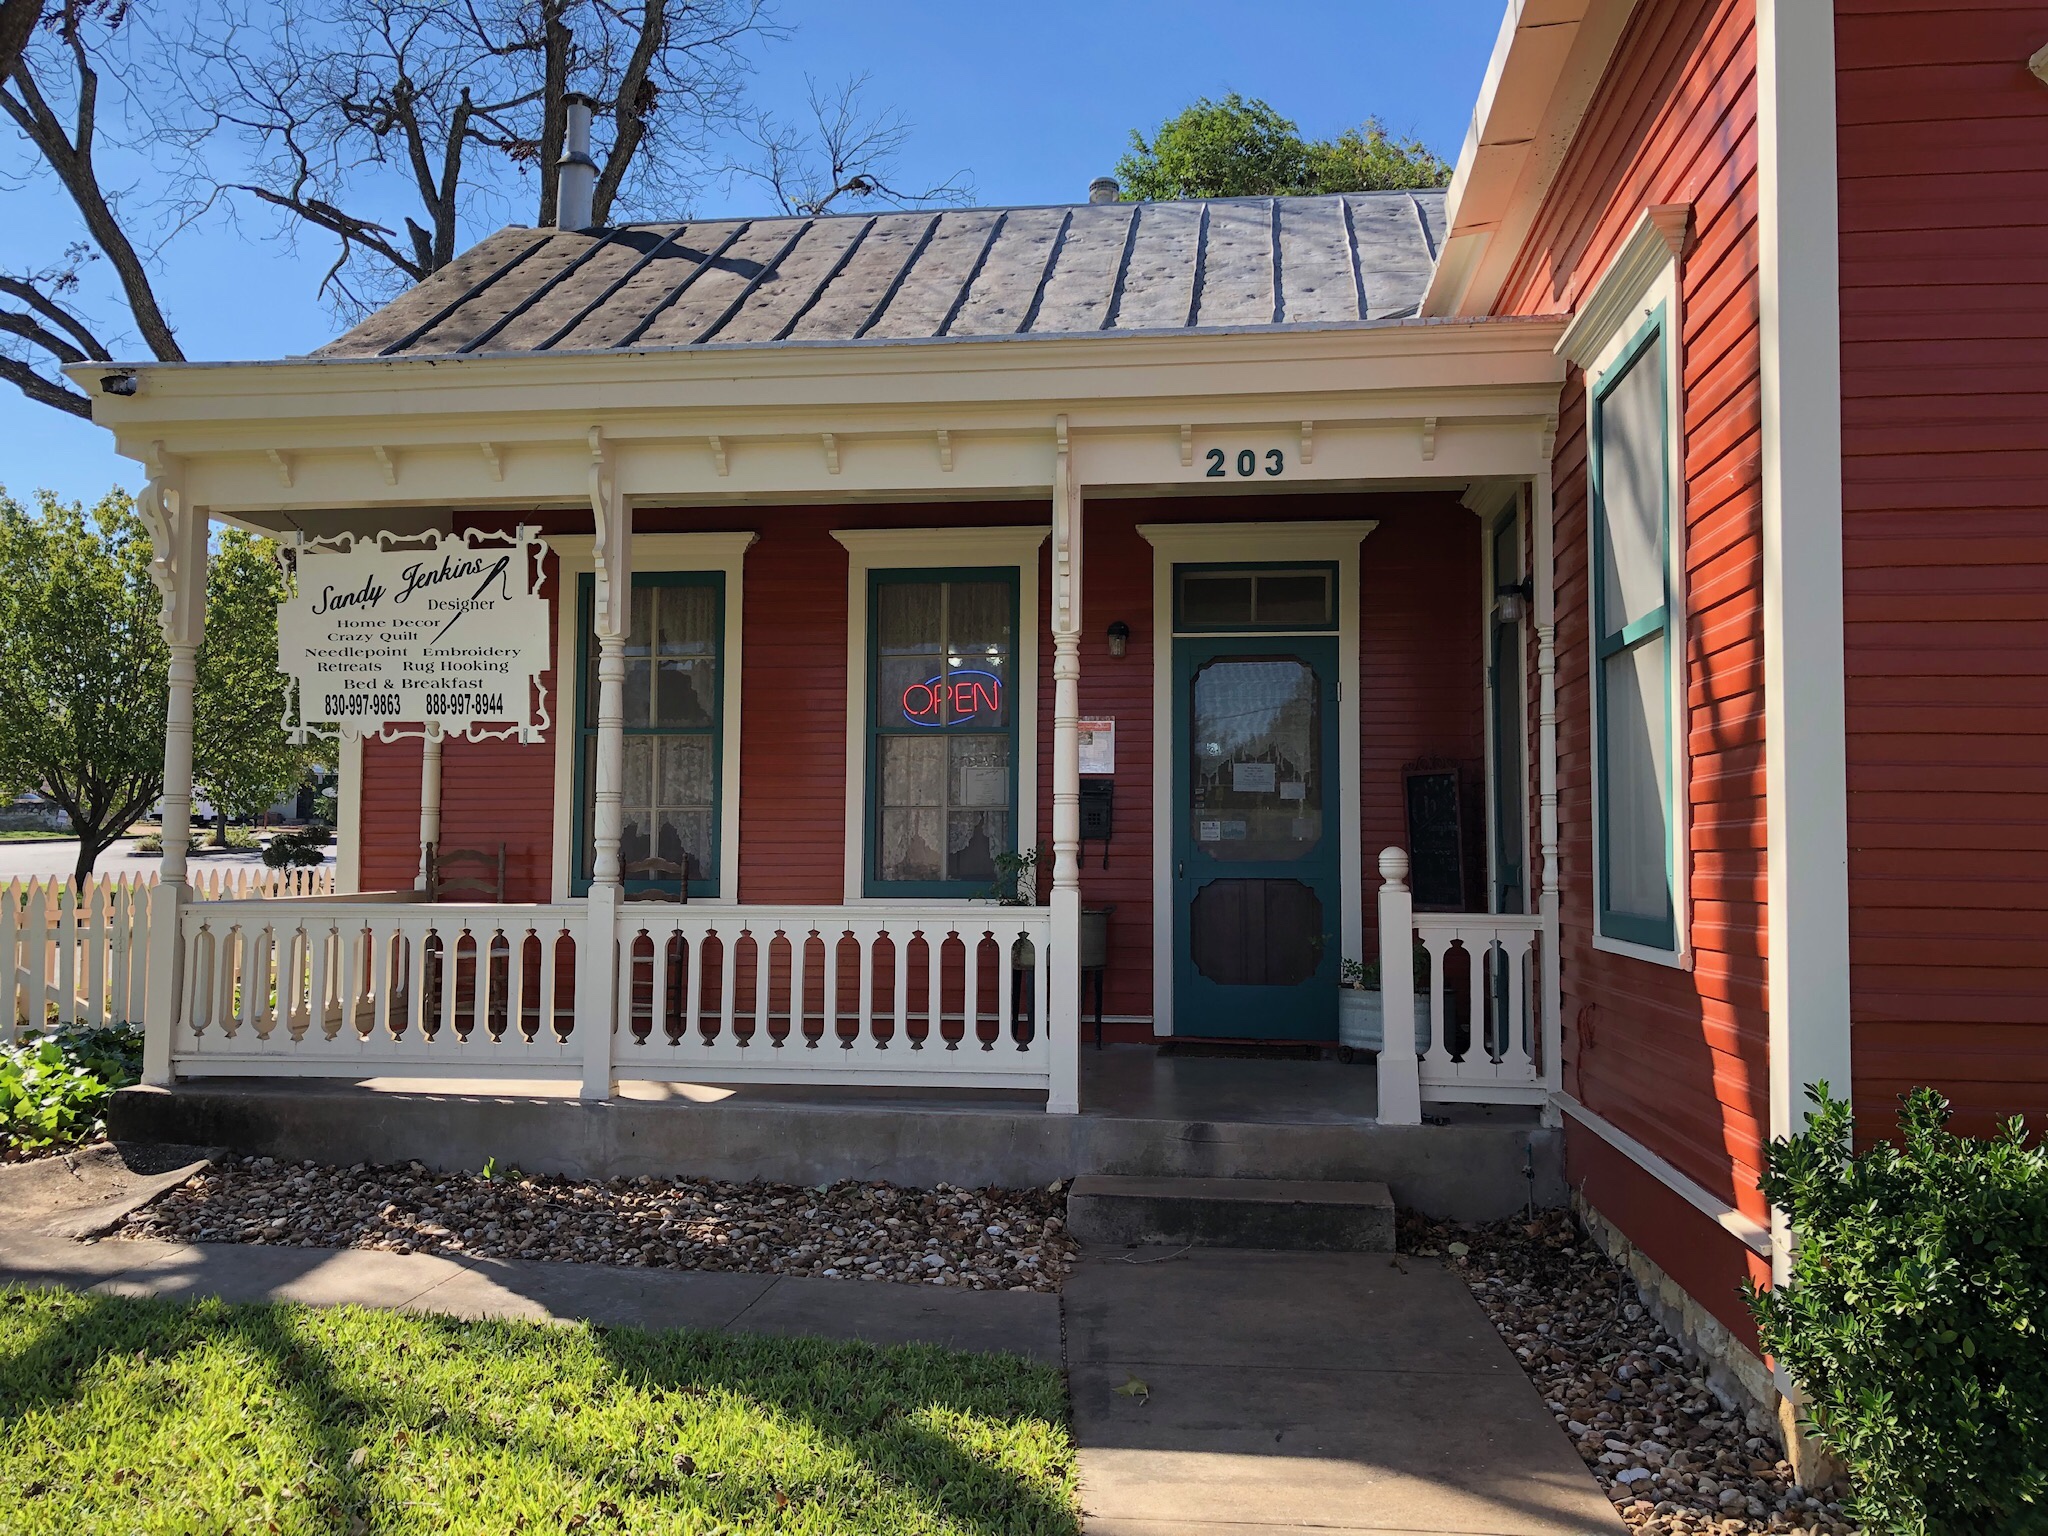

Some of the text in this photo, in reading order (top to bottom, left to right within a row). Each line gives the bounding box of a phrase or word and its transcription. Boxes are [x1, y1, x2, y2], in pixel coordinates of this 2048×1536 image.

[1206, 449, 1284, 477] 203
[312, 555, 483, 615] Sandy Jenkins
[428, 598, 495, 613] Designer
[337, 619, 440, 628] Home Decor
[327, 631, 418, 643] Crazy Quilt
[305, 646, 521, 659] Needlepoint Embroidery
[317, 660, 509, 674] Retreats Rug Hooking
[344, 677, 483, 689] Bed & Breakfast
[325, 693, 503, 716] 830-997-9863 888-997-8944
[903, 680, 998, 715] OPEN
